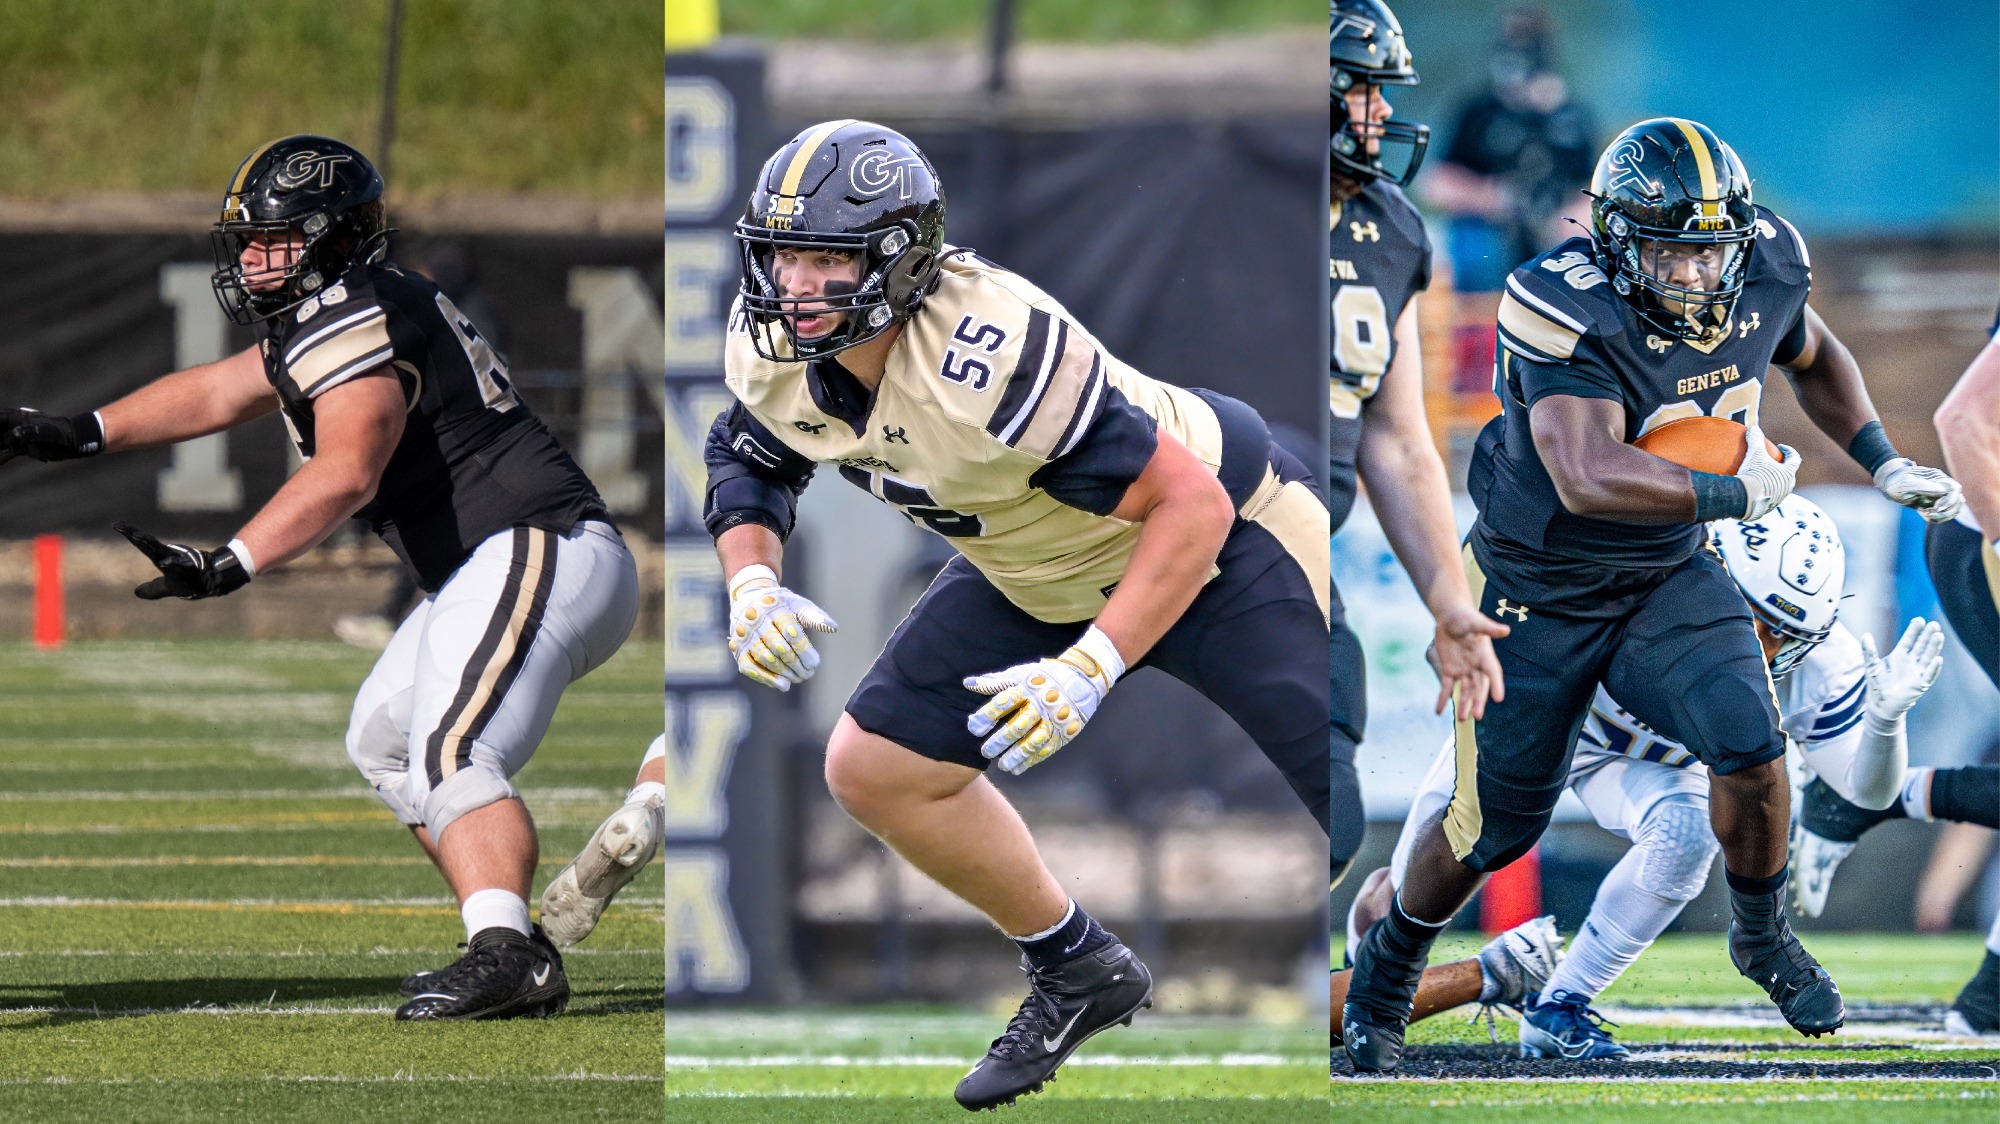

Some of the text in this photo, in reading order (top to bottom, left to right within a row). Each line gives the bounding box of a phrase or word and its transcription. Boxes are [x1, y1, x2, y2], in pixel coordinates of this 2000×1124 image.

[276, 150, 353, 188] GT
[850, 148, 926, 200] GT
[1608, 138, 1662, 197] GT
[765, 214, 793, 231] MTC
[1697, 218, 1724, 231] MTC
[1540, 251, 1610, 291] 30
[938, 310, 1009, 394] 55
[1676, 364, 1741, 396] GENEVA
